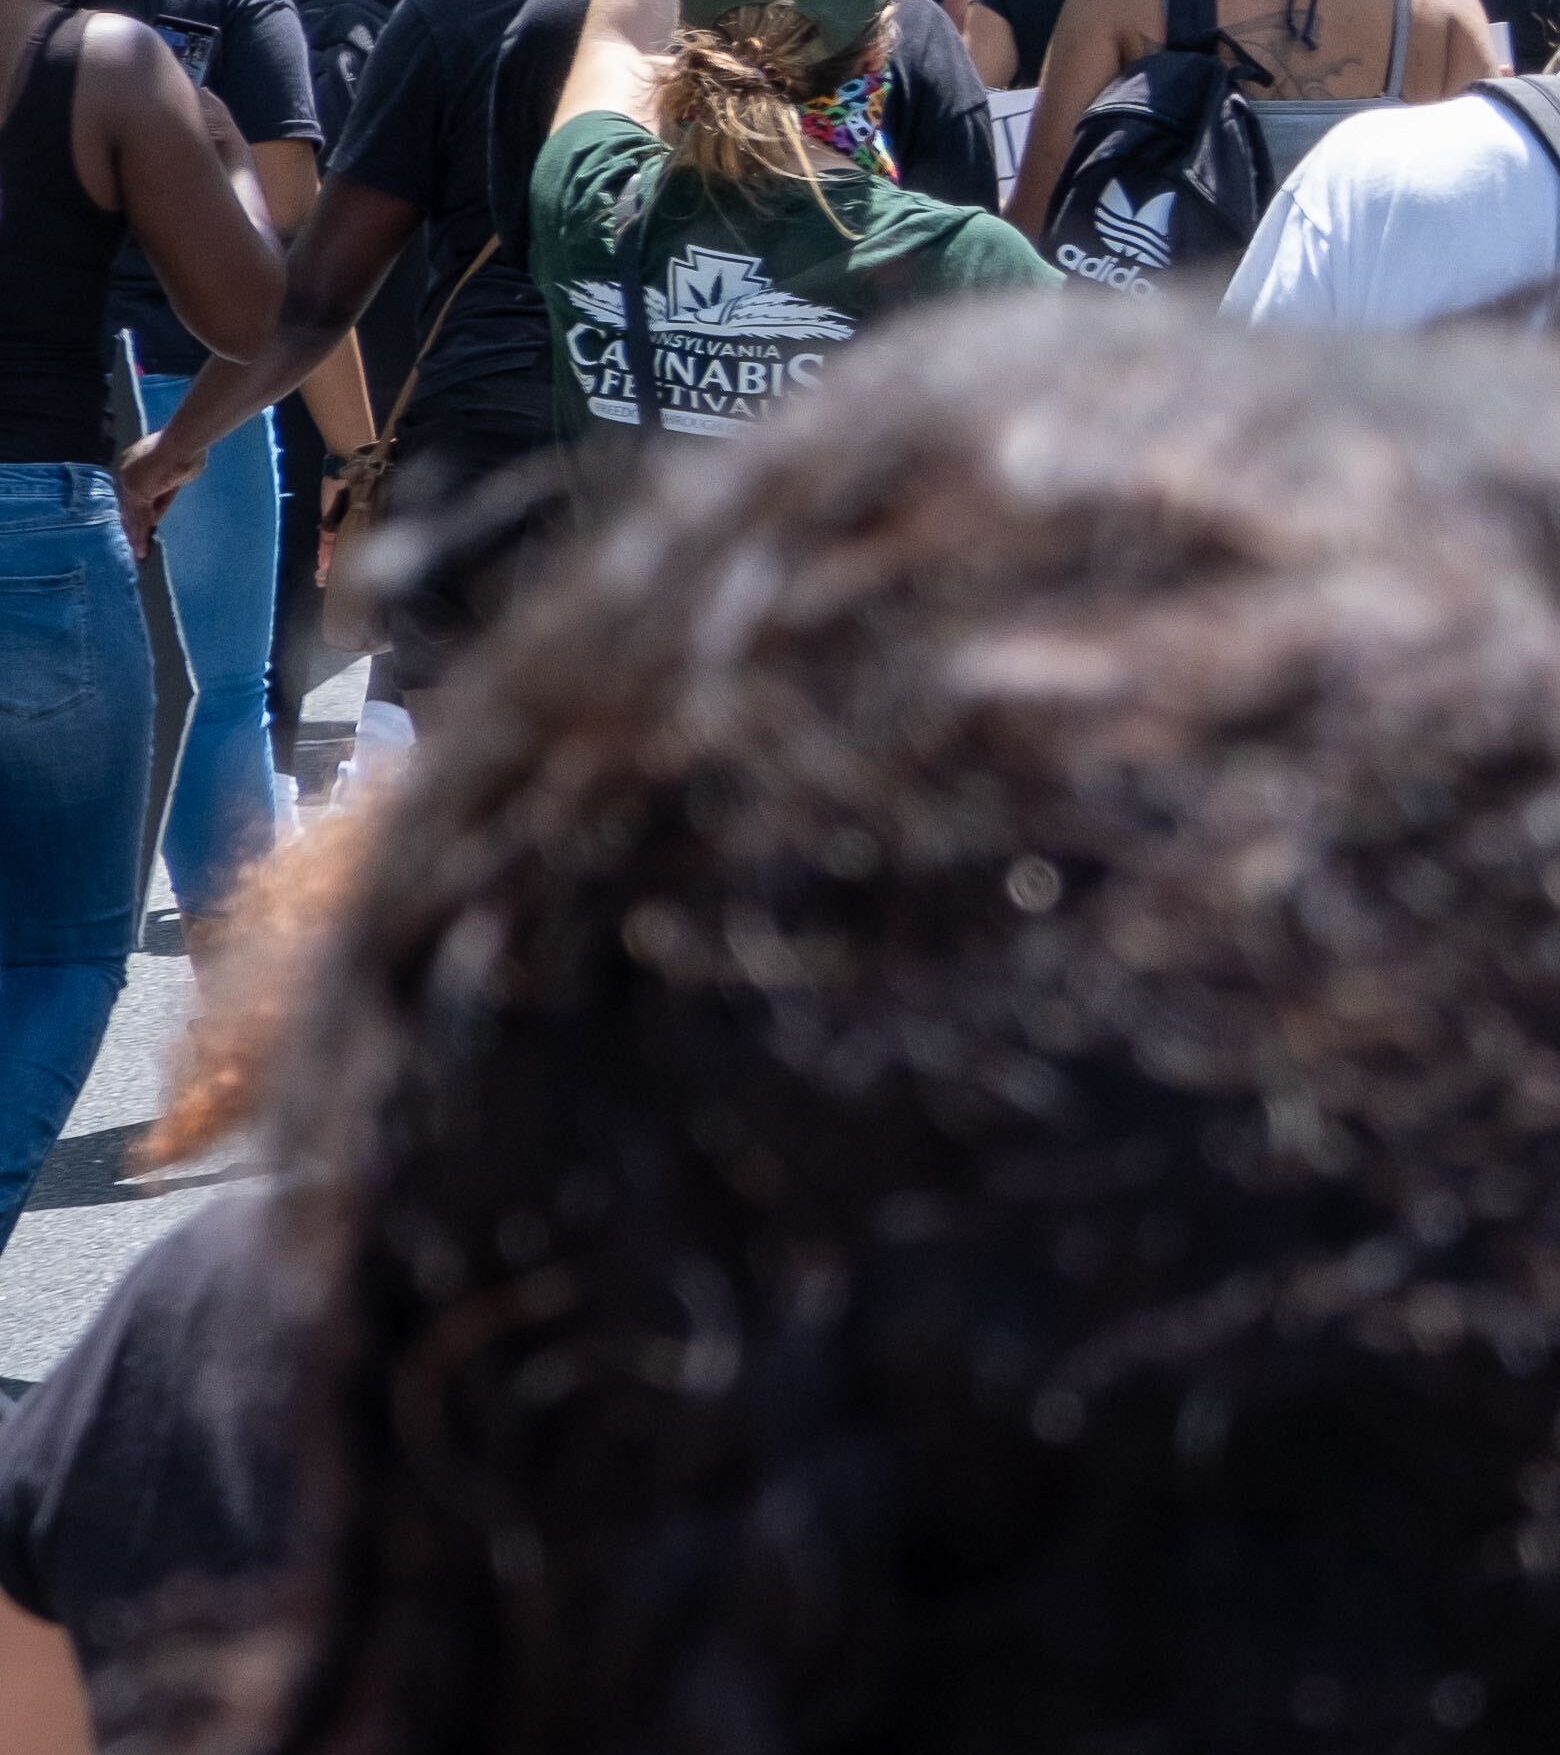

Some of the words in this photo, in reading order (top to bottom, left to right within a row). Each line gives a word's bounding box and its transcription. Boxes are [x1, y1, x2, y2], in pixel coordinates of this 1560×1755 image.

[1055, 243, 1160, 297] adida
[565, 321, 826, 397] CANABIS
[650, 331, 782, 360] NSYLVANIA
[599, 369, 770, 419] FETIVA
